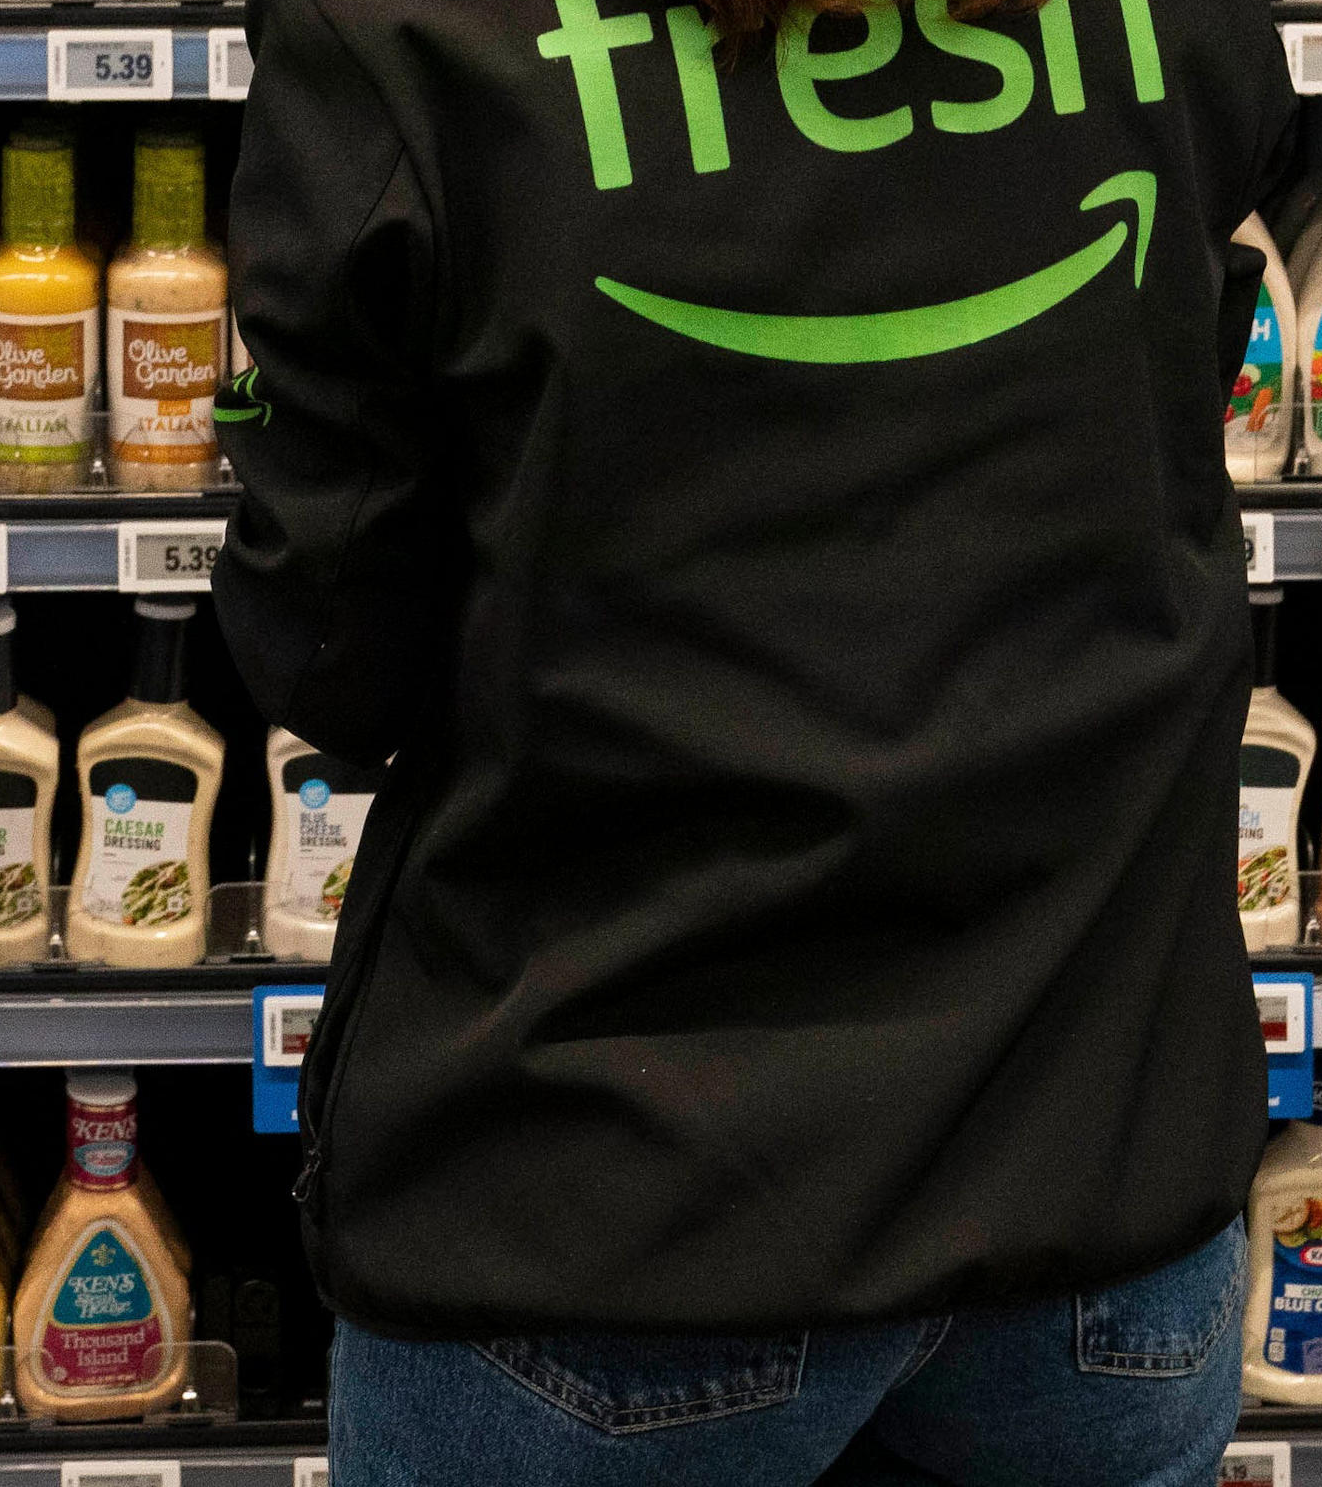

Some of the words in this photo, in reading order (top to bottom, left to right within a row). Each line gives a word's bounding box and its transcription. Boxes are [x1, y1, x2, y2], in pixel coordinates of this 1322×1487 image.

[95, 55, 152, 80] 5.39
[129, 338, 187, 367] Olive
[136, 362, 217, 388] Garden
[105, 819, 164, 838] CAESAR
[60, 1328, 145, 1348] Thousand
[78, 1347, 129, 1367] Island
